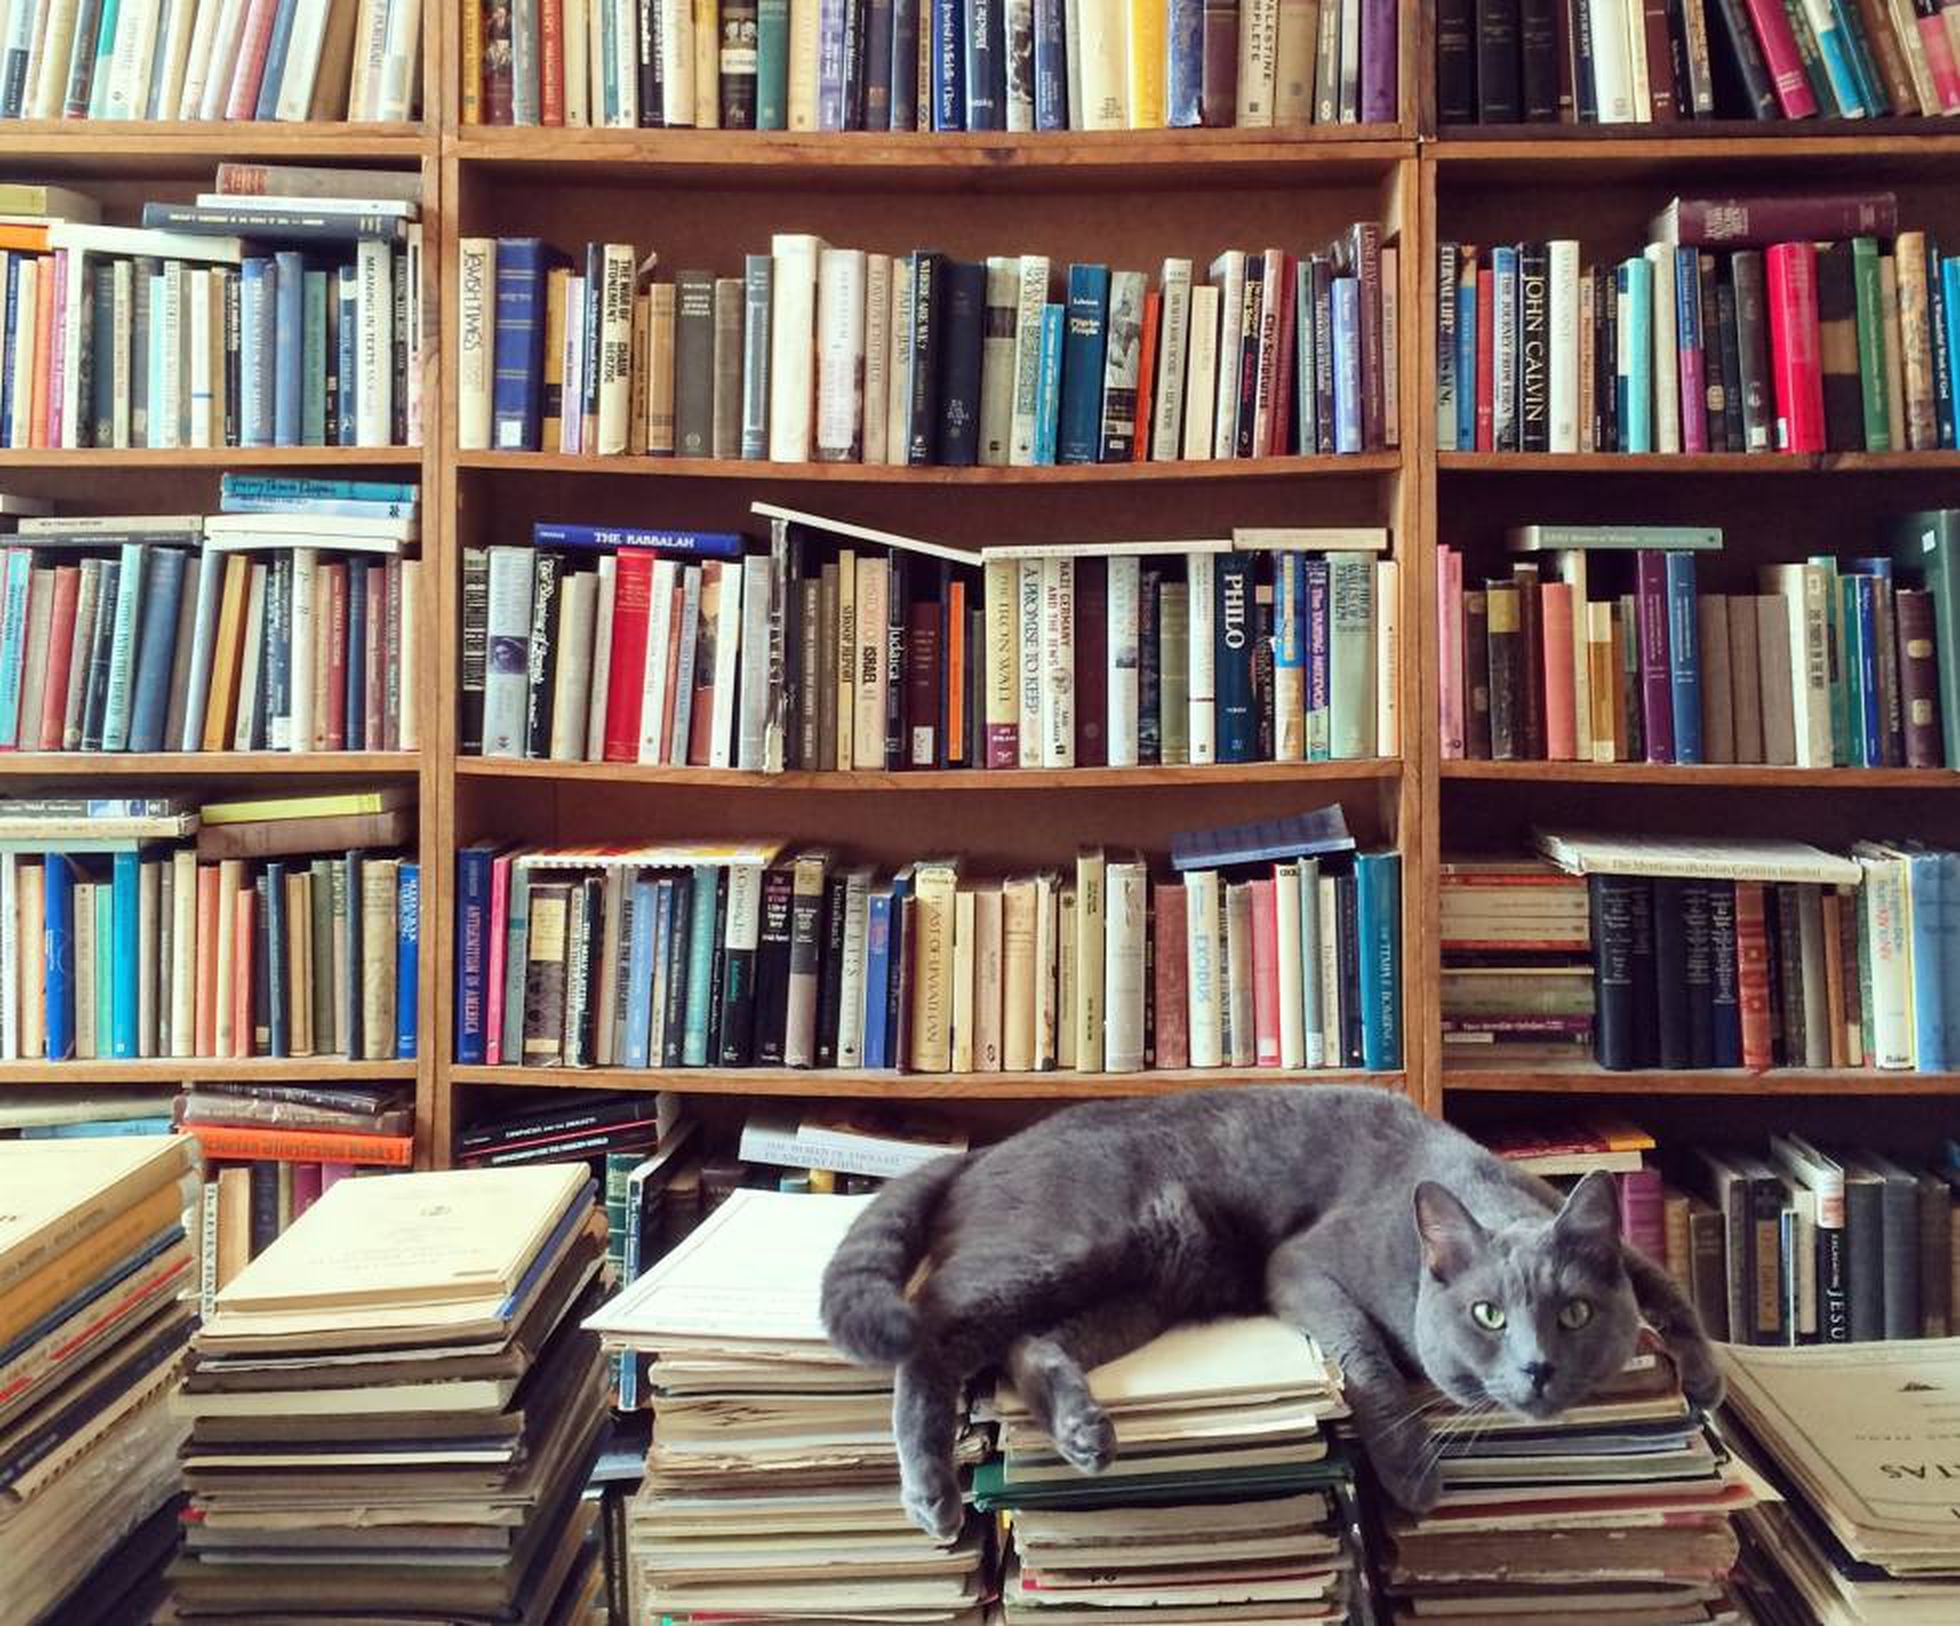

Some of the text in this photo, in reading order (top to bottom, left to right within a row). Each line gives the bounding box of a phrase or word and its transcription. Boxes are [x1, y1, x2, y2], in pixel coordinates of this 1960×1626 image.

[1251, 0, 1259, 62] MPLETE
[943, 44, 955, 84] Middle
[365, 256, 375, 365] MEANING IN TEXTS
[606, 258, 620, 323] ATONEMENT
[619, 260, 632, 322] THE WAR OF
[917, 302, 929, 322] ARE
[1440, 246, 1456, 334] ETERNAL LIFE?
[1500, 276, 1512, 414] THE JOURNEY FROM EDEN
[1521, 276, 1544, 422] JOHN CALVIN
[1935, 303, 1945, 345] Wonderful
[604, 341, 615, 384] HERZOG
[617, 342, 627, 377] CHAIM
[1260, 313, 1276, 409] City Scriptures
[1939, 381, 1949, 399] God
[594, 532, 694, 548] THE KABBALAH
[1311, 588, 1323, 608] The
[1347, 563, 1358, 619] WALLS OF
[1360, 564, 1371, 584] THE
[532, 580, 554, 631] Shaping
[998, 602, 1010, 650] IRON
[1047, 585, 1058, 667] AND THE JEWS
[1060, 561, 1070, 647] NAZI GERMANY
[1224, 574, 1244, 649] PHILO
[464, 632, 486, 651] FOR
[842, 605, 853, 684] STROOP REPORT
[863, 646, 877, 685] ISRAEL
[888, 624, 905, 681] Judaica
[1023, 566, 1040, 715] A PROMISE TO KEEP
[998, 657, 1010, 704] WALL
[466, 905, 480, 973] ANTISEMITISM
[620, 945, 631, 961] THE
[930, 939, 941, 957] OF
[1195, 935, 1210, 1003] EXODUS
[1380, 943, 1390, 987] TEMPLE
[465, 991, 479, 1034] AMERICA
[579, 971, 588, 1010] LETTER
[617, 966, 630, 1021] HOLOCAUST
[927, 959, 940, 1043] LEVIATHAN
[205, 1212, 214, 1259] SEVEN
[1826, 1290, 1848, 1339] JESU
